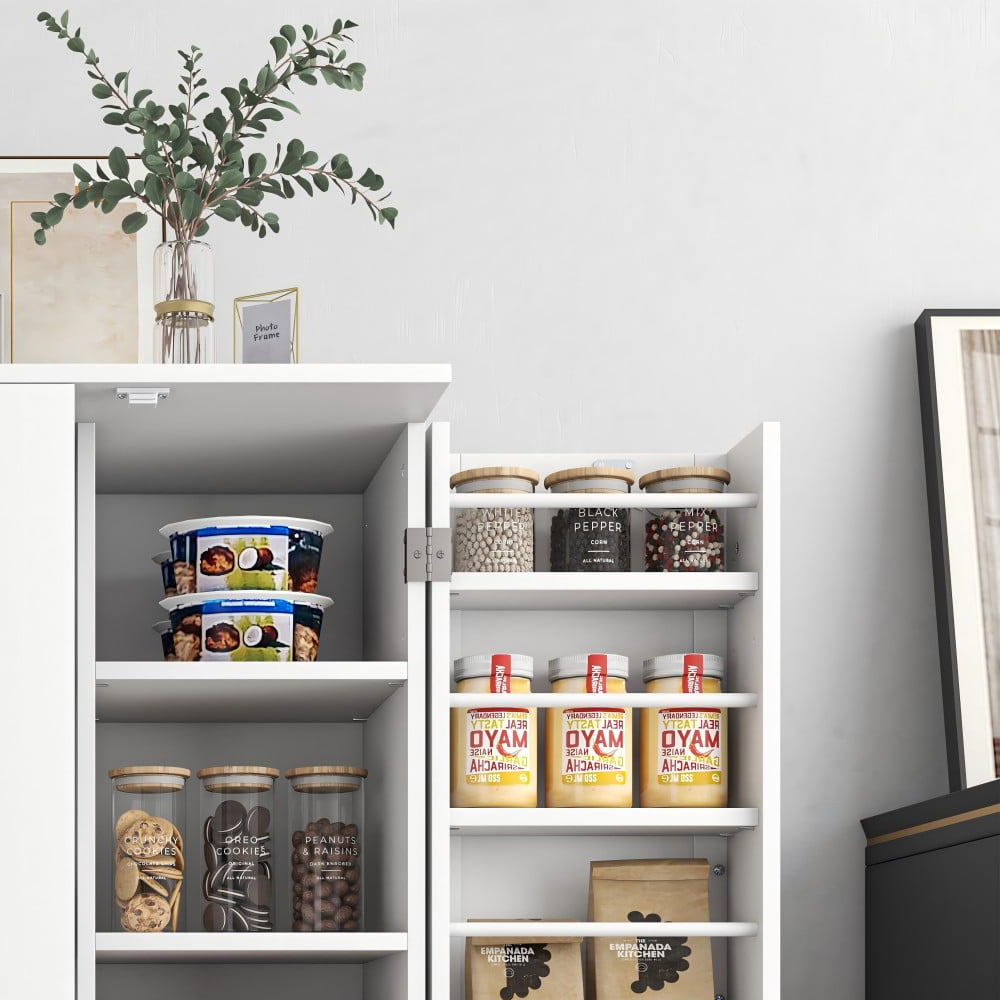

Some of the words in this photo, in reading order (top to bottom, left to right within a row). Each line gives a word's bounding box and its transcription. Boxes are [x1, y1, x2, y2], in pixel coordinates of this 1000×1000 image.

[256, 322, 278, 332] Photo
[254, 332, 280, 342] Frame
[578, 508, 618, 518] BLACK
[684, 508, 706, 517] MIX
[574, 521, 622, 532] PEPPER
[670, 521, 718, 532] PEPPER
[125, 836, 178, 844] CRUNCHY
[226, 836, 258, 844] OREO
[306, 836, 356, 844] PEANUTS
[126, 847, 176, 856] COOKIES
[216, 846, 266, 856] COOKIES
[302, 848, 308, 856] &
[314, 847, 358, 856] RAISINS
[480, 947, 535, 955] EMPANADA
